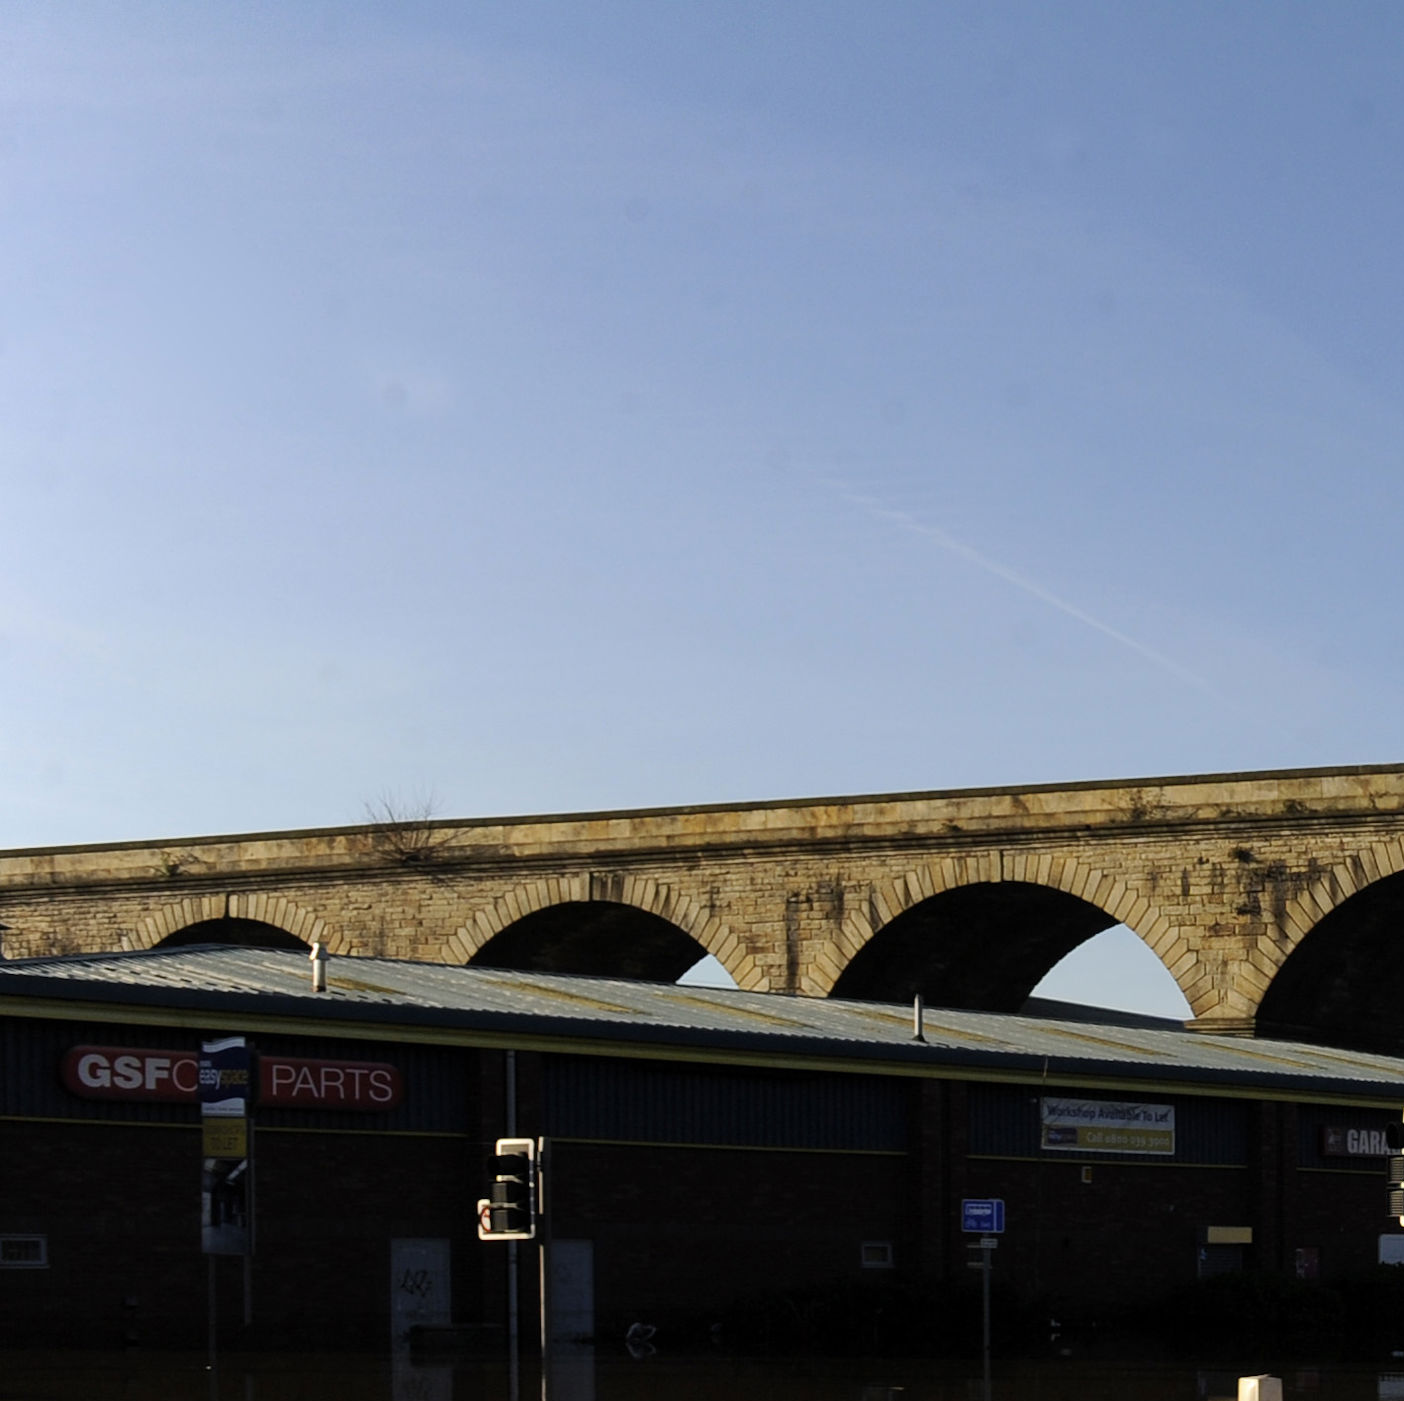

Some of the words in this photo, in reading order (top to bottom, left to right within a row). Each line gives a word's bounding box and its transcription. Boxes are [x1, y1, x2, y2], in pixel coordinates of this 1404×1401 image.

[271, 1064, 394, 1103] PARTS
[1047, 1105, 1096, 1121] Workshop
[1142, 1110, 1153, 1121] To
